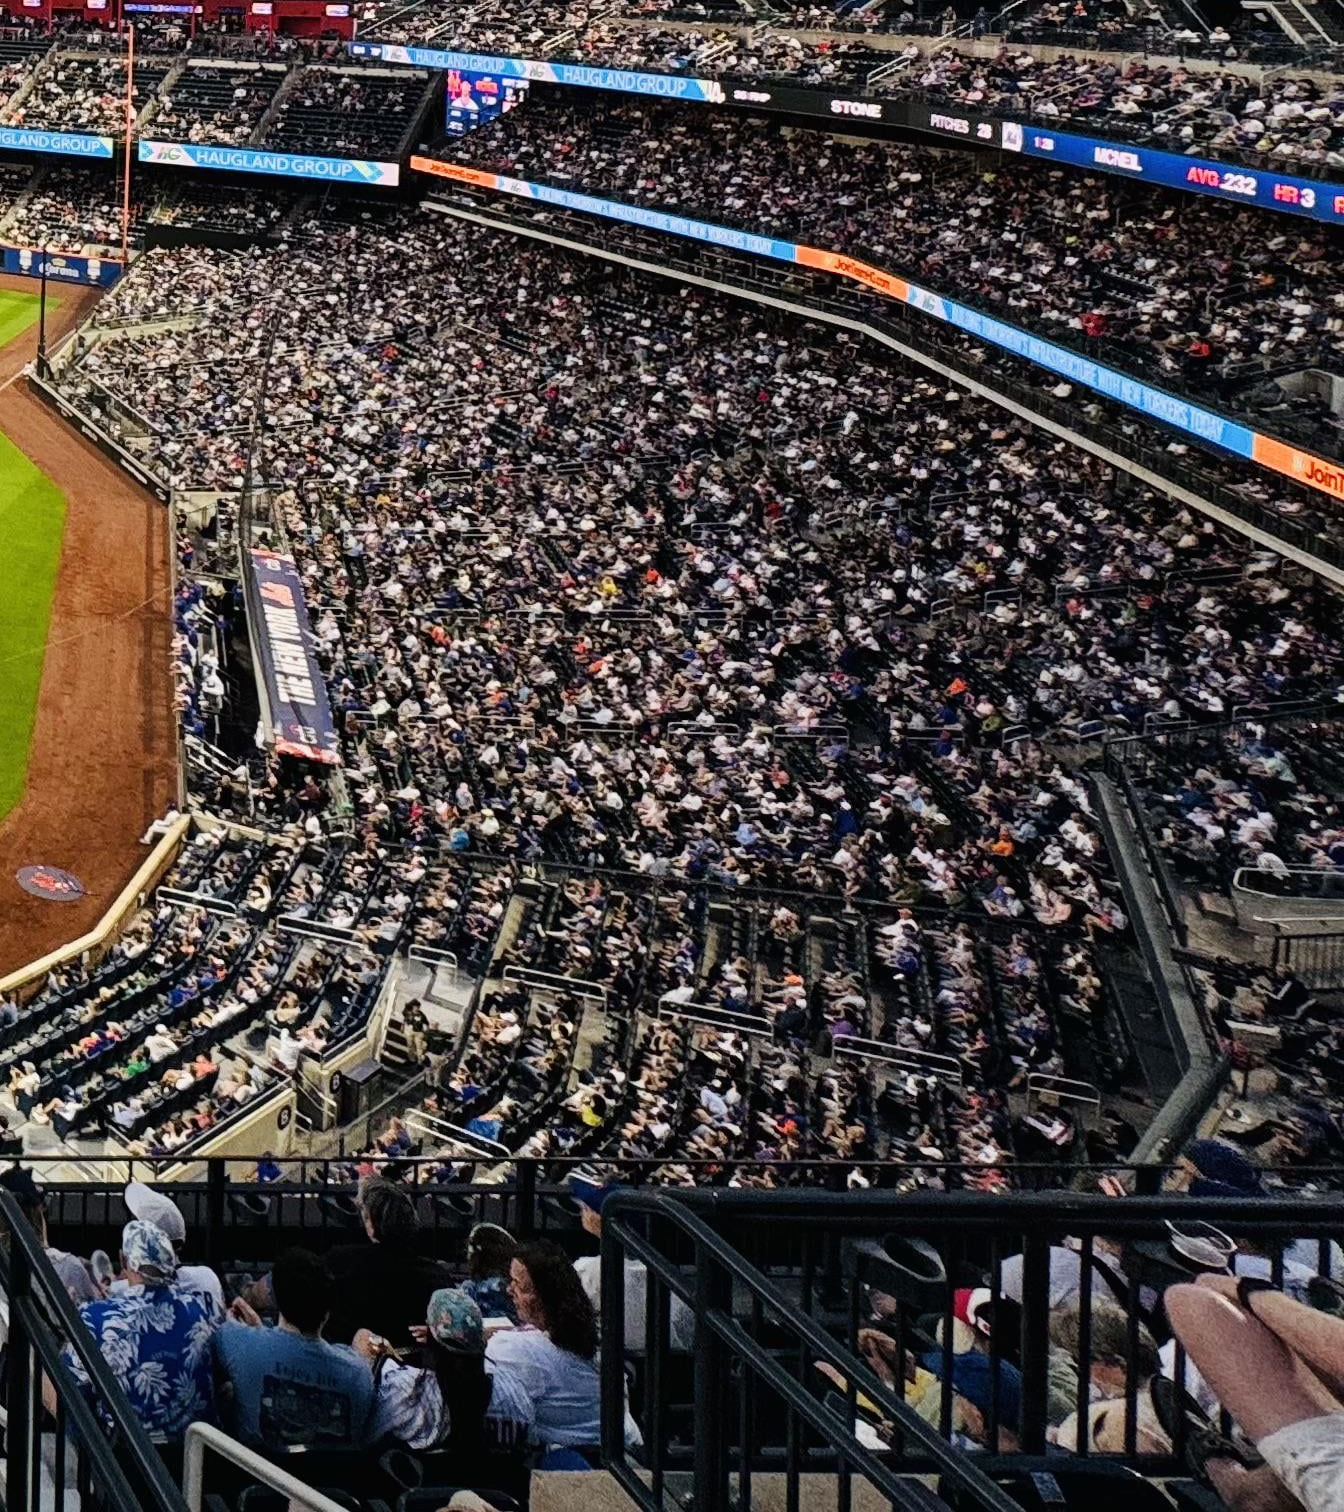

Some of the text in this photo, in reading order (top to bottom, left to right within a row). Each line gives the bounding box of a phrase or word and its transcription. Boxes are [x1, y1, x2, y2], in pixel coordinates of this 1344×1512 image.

[565, 69, 687, 97] HAUGLAND GROUP
[830, 100, 881, 118] STONE
[930, 113, 969, 133] PITCHES
[51, 137, 100, 153] GROUP
[196, 151, 352, 176] HAUGLAND GROUP
[1094, 147, 1143, 171] MCNEIL
[1187, 167, 1218, 187] AVG
[1219, 173, 1257, 195] .232
[1274, 184, 1299, 203] HR
[1300, 188, 1315, 208] 3
[39, 261, 79, 278] Corona
[263, 604, 302, 641] YORK
[270, 639, 310, 678] NEW
[275, 674, 316, 706] THE
